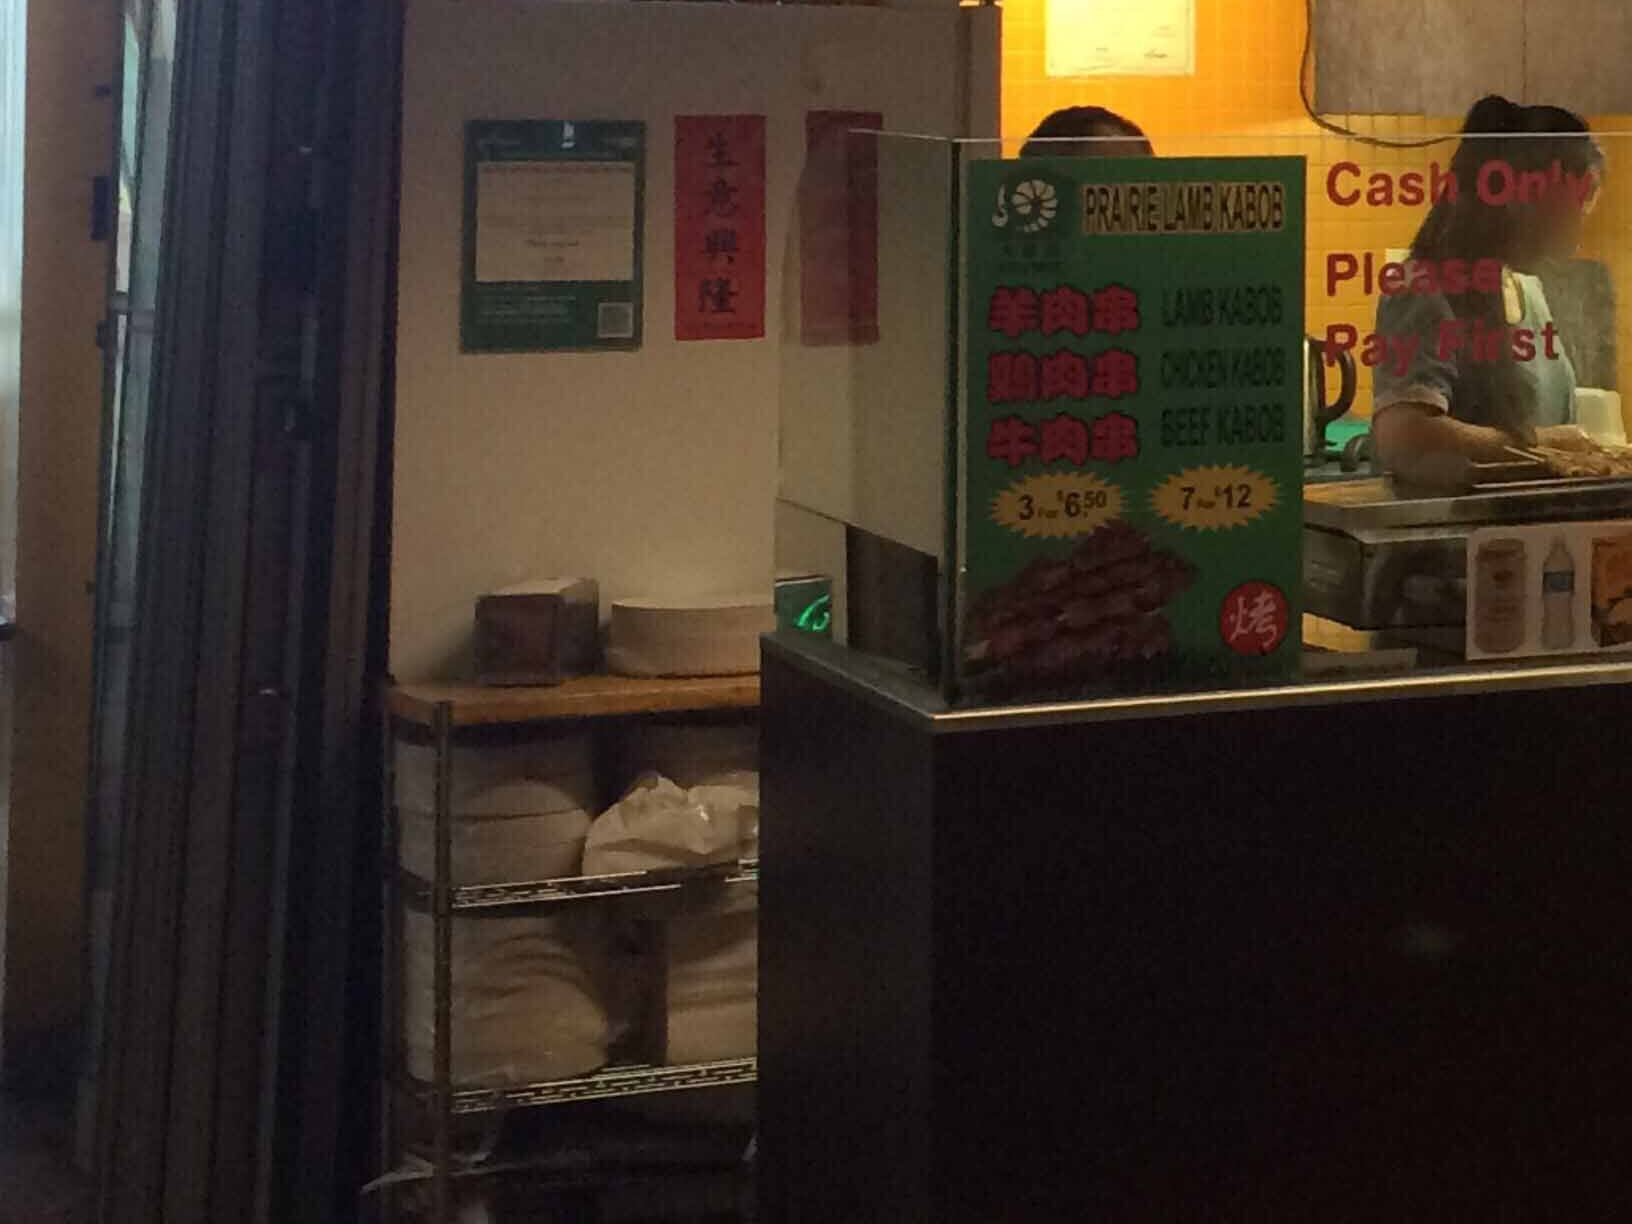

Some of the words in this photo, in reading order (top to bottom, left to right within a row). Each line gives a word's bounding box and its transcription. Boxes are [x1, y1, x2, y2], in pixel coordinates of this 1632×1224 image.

[1326, 160, 1458, 207] Cash
[1085, 185, 1161, 232] PRAIRIE
[1163, 185, 1215, 232] LAMB
[1218, 184, 1284, 231] KABOB
[1326, 251, 1504, 297] Please
[988, 284, 1141, 337] 羊肉串
[1161, 286, 1215, 327] LAMB
[1217, 284, 1283, 327] KABOB
[1325, 323, 1420, 376] Pay
[1438, 320, 1560, 362] First
[1161, 407, 1211, 447] BEEF
[1216, 403, 1285, 446] KABOB
[1018, 494, 1035, 521] 3
[1180, 487, 1195, 510] 7
[1228, 595, 1283, 649] 烤
